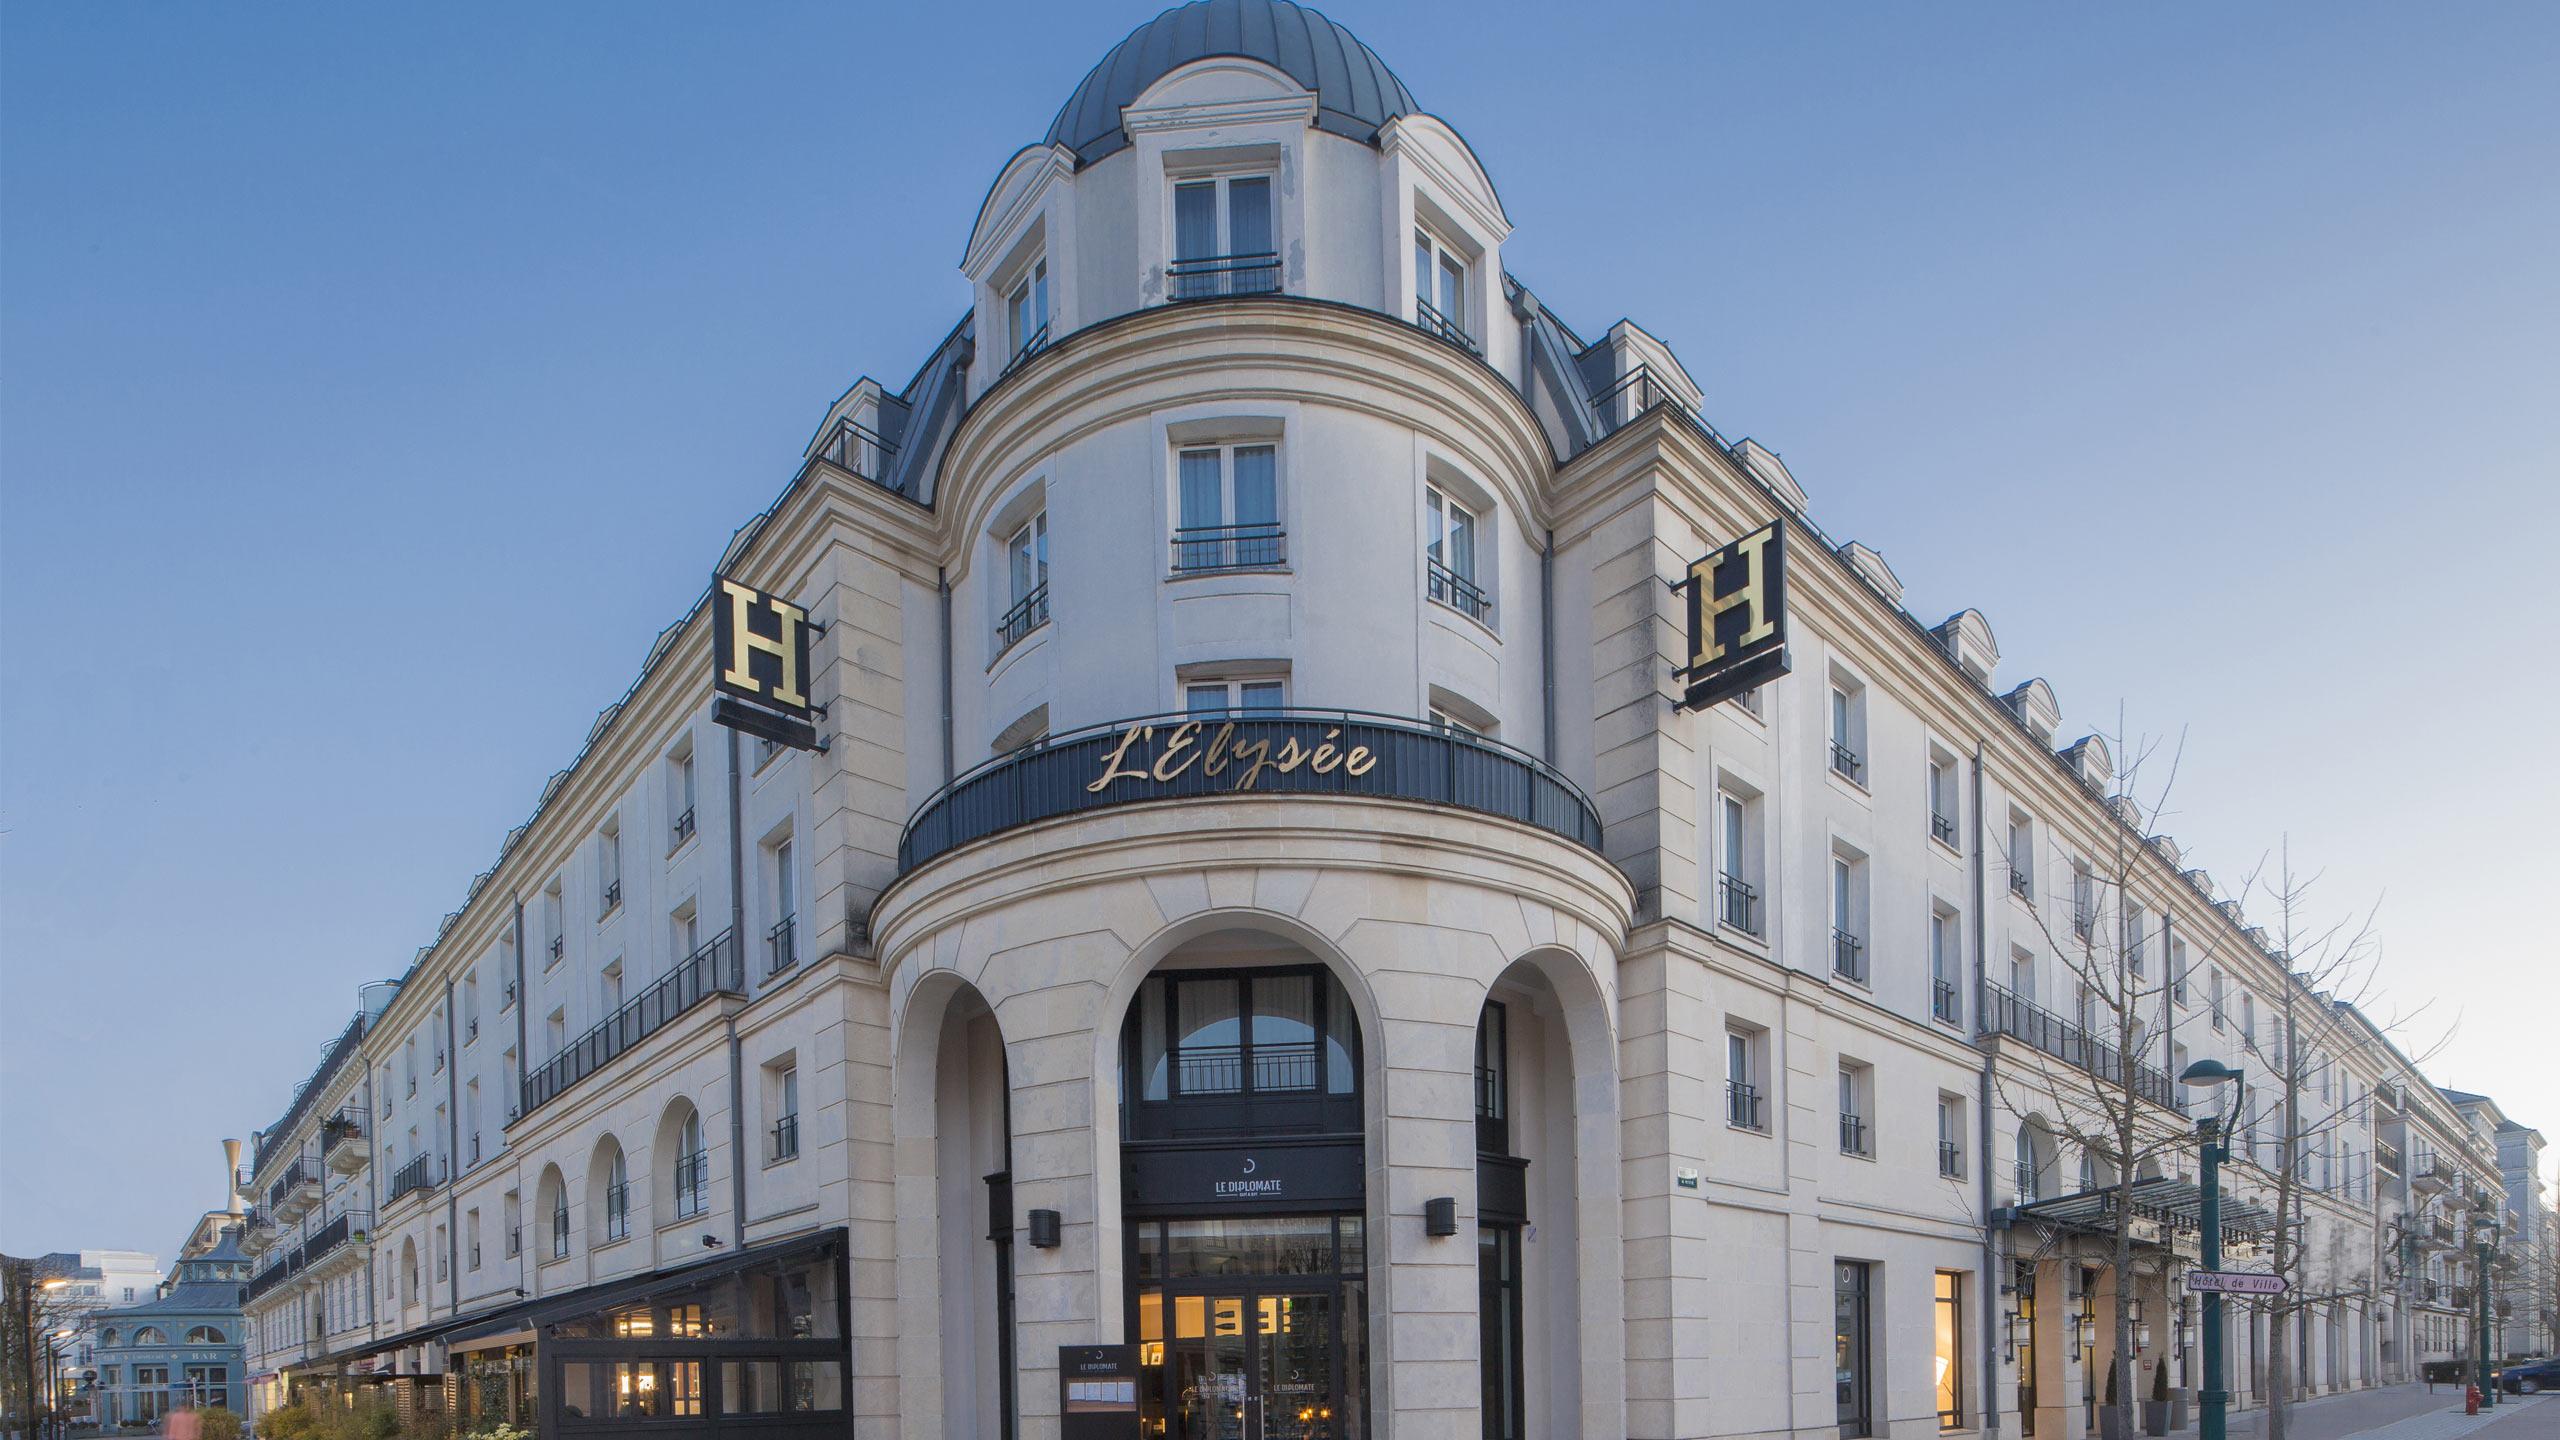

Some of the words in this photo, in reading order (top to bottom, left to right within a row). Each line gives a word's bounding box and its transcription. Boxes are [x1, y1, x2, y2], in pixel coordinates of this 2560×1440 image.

[1691, 526, 1775, 669] H
[722, 579, 806, 709] H
[1086, 719, 1377, 793] L'Elysée
[1215, 1181, 1227, 1193] LE
[1228, 1180, 1282, 1192] DIPLOMATE
[2194, 1274, 2225, 1287] Hôtel
[2231, 1276, 2245, 1288] de
[2252, 1278, 2279, 1291] Ville
[191, 1352, 218, 1360] BAR
[1080, 1363, 1087, 1371] LE
[1087, 1362, 1118, 1370] DIPLOMATE
[1273, 1384, 1280, 1392] LE
[1281, 1383, 1315, 1392] DIPLOMATE
